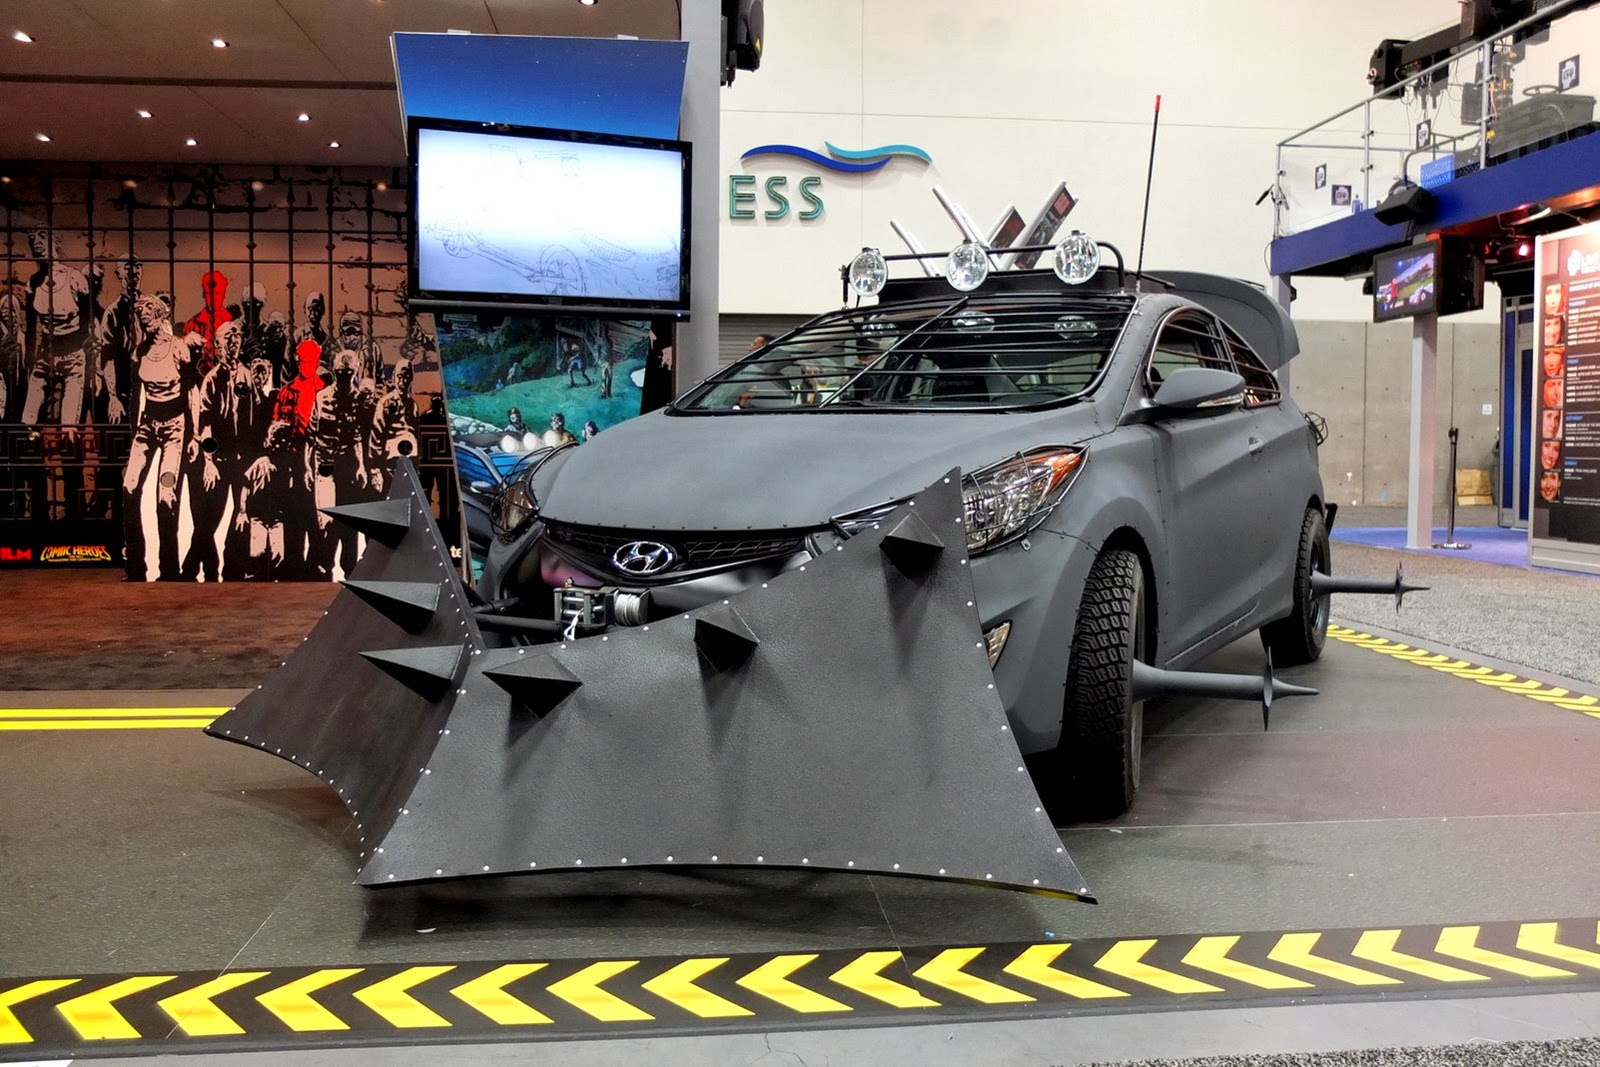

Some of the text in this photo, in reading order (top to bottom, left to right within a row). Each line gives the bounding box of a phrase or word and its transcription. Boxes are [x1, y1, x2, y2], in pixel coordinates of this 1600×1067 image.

[729, 174, 824, 220] ESS
[0, 547, 32, 560] ILM
[40, 546, 71, 561] COMIC
[72, 545, 111, 561] HEROES
